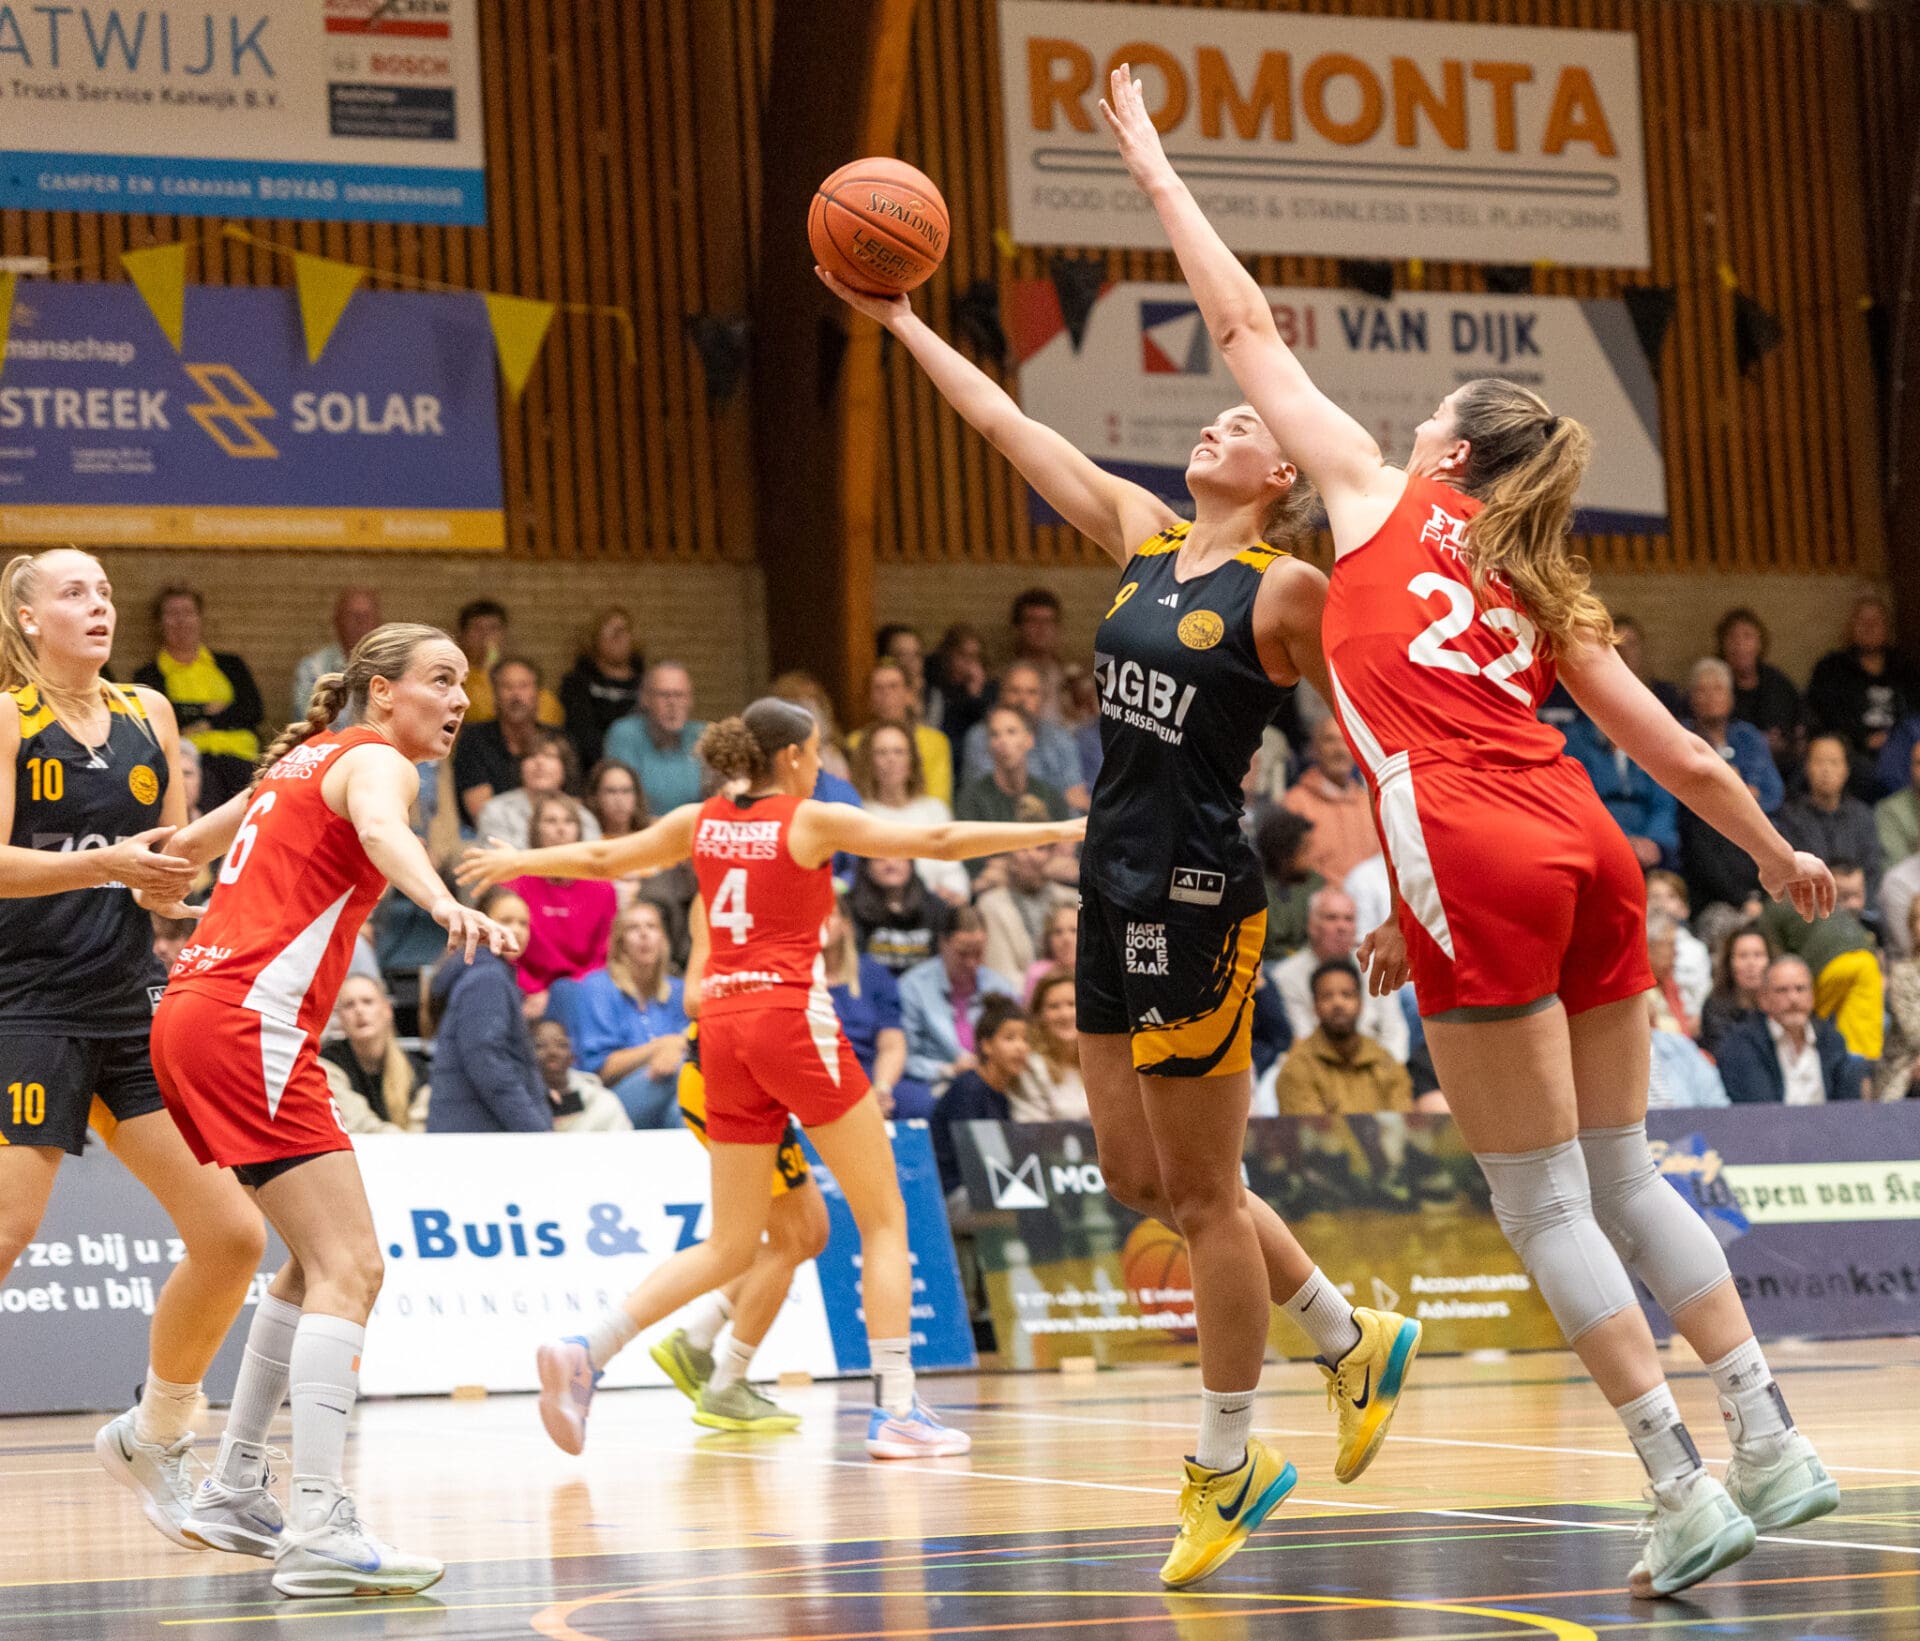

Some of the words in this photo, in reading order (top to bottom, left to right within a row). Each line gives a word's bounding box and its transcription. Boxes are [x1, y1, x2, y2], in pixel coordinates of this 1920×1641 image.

[14, 80, 69, 99] Truck
[77, 81, 152, 102] Service
[161, 86, 236, 110] Katwijk
[1026, 36, 1619, 158] ROMONTA
[866, 191, 943, 251] SPALDING
[1270, 305, 1319, 350] BI
[1338, 307, 1427, 352] VAN
[1452, 310, 1540, 363] DIJK
[0, 387, 170, 430] STREEK
[292, 391, 442, 435] SOLAR
[1105, 582, 1139, 619] 9
[1407, 571, 1536, 708] 22
[26, 757, 64, 801] 10
[219, 790, 276, 885] 6
[695, 839, 777, 860] PROFILES
[697, 819, 782, 842] FINISH
[710, 868, 754, 945] 4
[1127, 922, 1166, 937] HART
[1126, 961, 1169, 975] ZAAK
[7, 1082, 45, 1125] 10
[1817, 1182, 1874, 1205] van
[586, 1203, 648, 1257] &
[78, 1233, 129, 1272] bij
[133, 1240, 161, 1263] u
[73, 1286, 99, 1311] u
[104, 1277, 155, 1316] bij
[1411, 1274, 1531, 1293] Accountants
[1416, 1299, 1511, 1319] Adviseurs
